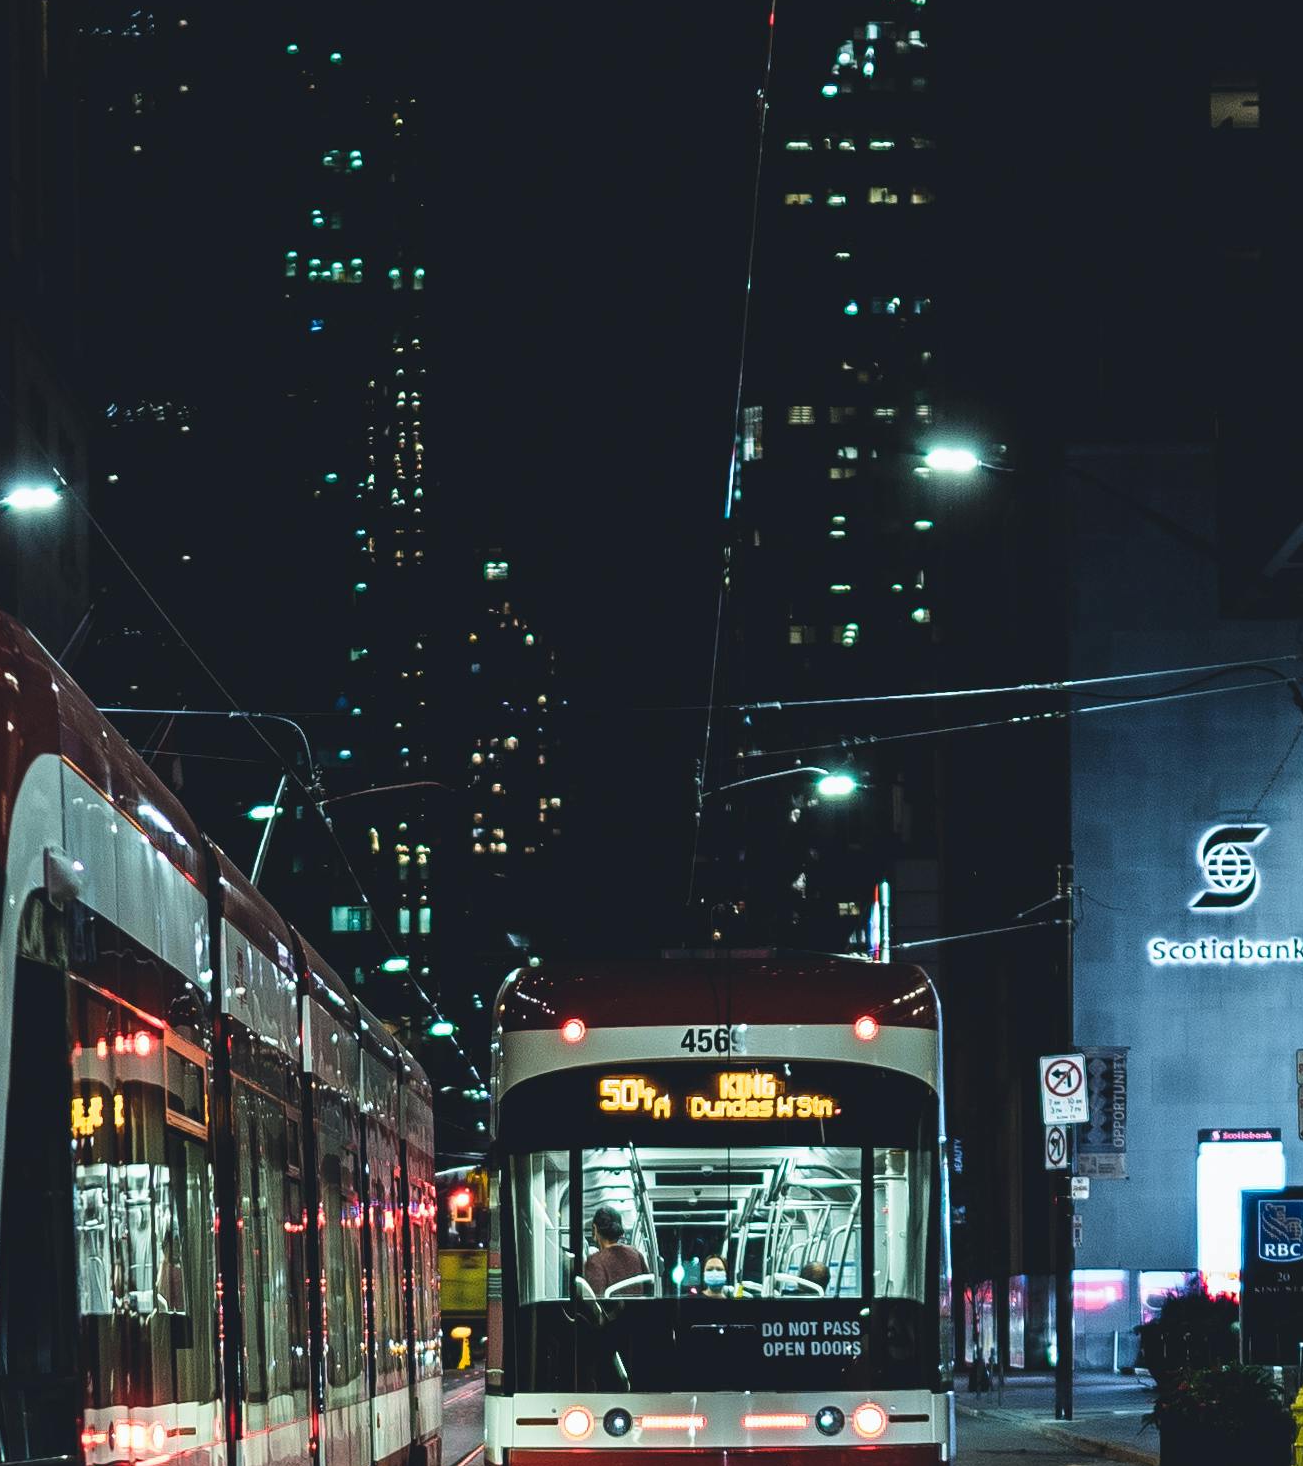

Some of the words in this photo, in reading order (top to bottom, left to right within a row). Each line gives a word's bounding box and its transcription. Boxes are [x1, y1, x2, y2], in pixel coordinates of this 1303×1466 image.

[719, 1074, 776, 1100] KING
[690, 1096, 774, 1118] Dundas
[1113, 1053, 1125, 1148] OPPORTUNITY
[1264, 1242, 1301, 1257] RBC
[761, 1322, 784, 1337] DO
[788, 1321, 818, 1336] NOT
[823, 1320, 861, 1335] PASS
[763, 1341, 805, 1357] OPEN
[810, 1340, 862, 1355] DOORS
